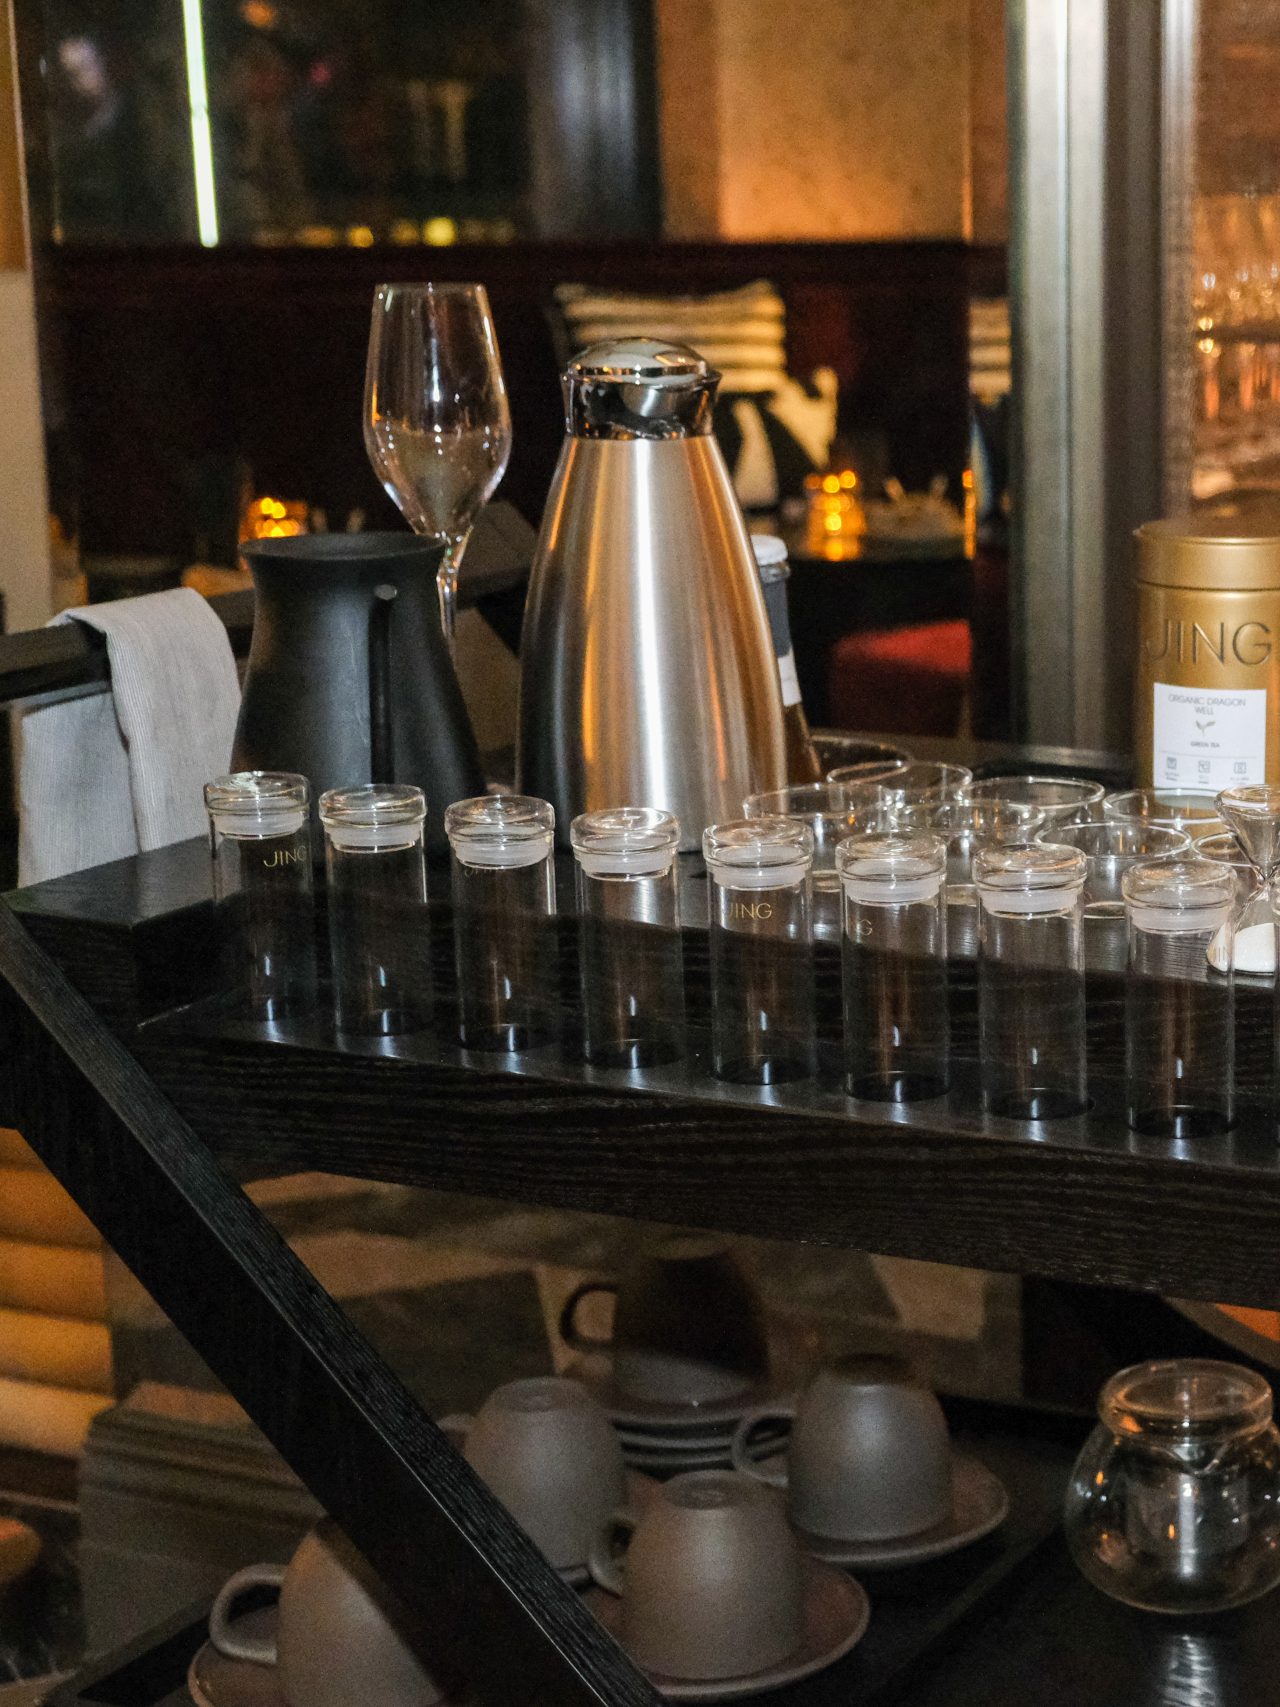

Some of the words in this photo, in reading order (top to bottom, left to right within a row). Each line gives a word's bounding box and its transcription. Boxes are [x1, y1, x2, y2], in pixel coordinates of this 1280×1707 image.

[1146, 619, 1272, 666] JING
[1168, 694, 1206, 706] ORGANIC
[1207, 697, 1246, 707] DRAGON
[1195, 706, 1215, 715] WELL
[729, 902, 773, 919] JING
